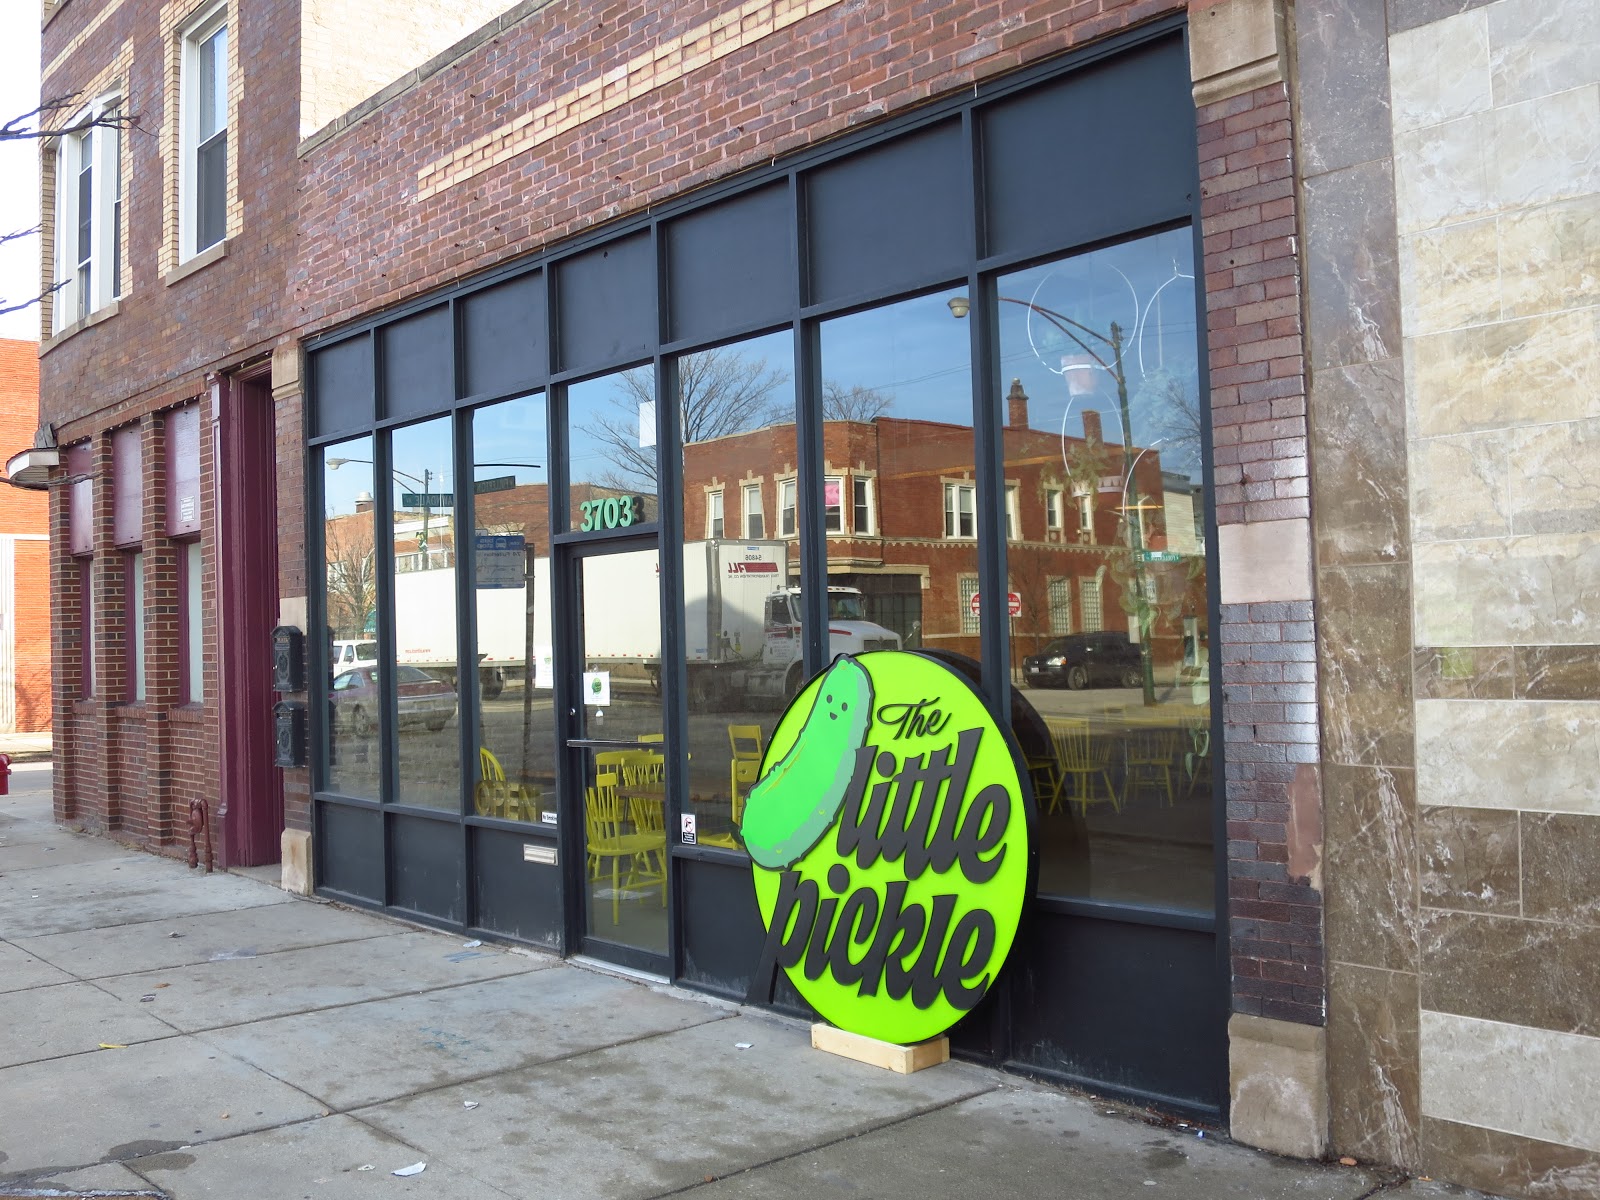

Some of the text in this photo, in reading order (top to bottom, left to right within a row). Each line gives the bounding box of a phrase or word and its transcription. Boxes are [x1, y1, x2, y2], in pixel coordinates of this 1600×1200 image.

[580, 495, 633, 533] 3703
[876, 696, 952, 740] The
[475, 780, 537, 824] OPEN
[835, 727, 1012, 885] little
[746, 863, 997, 1011] pickle
